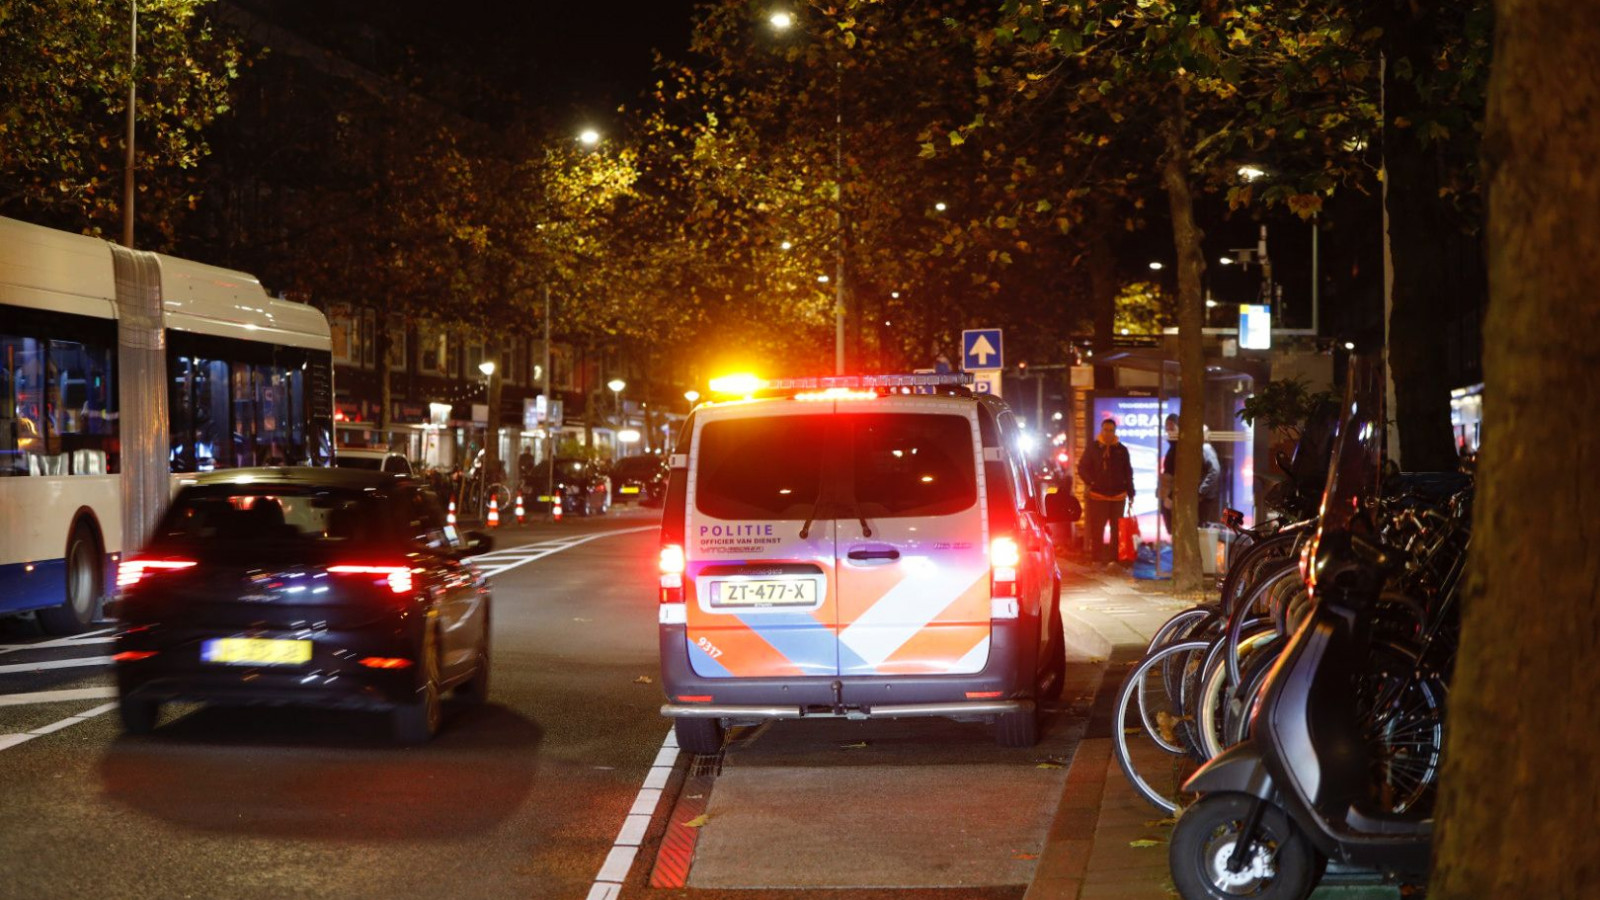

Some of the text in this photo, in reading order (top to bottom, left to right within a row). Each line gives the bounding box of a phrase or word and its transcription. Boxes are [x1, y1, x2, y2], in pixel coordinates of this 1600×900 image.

[700, 524, 773, 537] POLITIE
[728, 583, 804, 600] ZT-477-X
[697, 636, 723, 658] 9317
